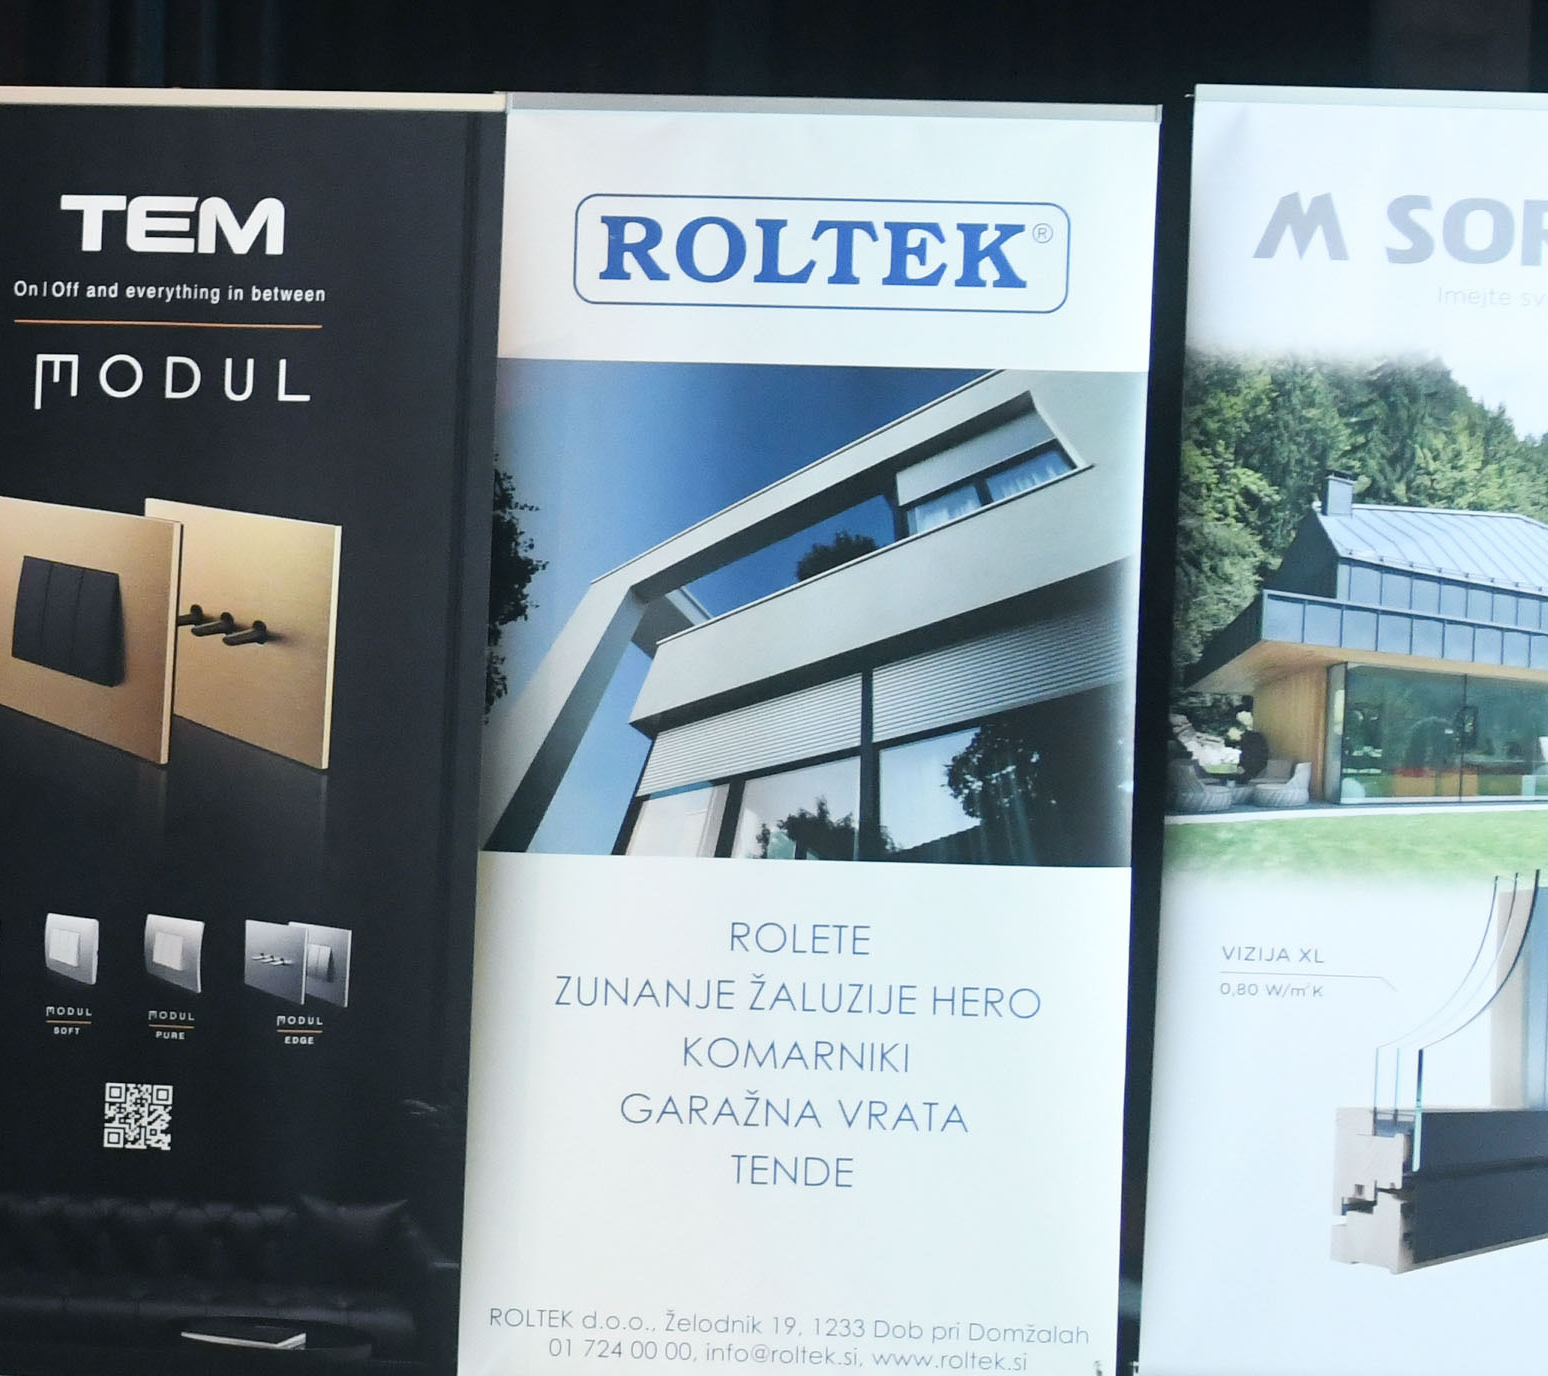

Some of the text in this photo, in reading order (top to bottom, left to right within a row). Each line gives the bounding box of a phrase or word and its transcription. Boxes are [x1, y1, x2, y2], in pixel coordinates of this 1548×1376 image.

[61, 195, 285, 255] TEM
[86, 282, 118, 298] and
[125, 284, 220, 304] everything
[228, 285, 243, 301] in
[251, 286, 326, 302] between
[34, 354, 310, 409] MODUL
[730, 922, 871, 955] ROLETE
[1221, 946, 1325, 963] VIZIJA XL
[555, 974, 1041, 1019] ZUNANJE ŽALUZIJE HERO
[1219, 982, 1259, 997] 0,80
[54, 1026, 80, 1035] SOFT
[156, 1031, 185, 1040] PURE
[284, 1036, 314, 1044] EDGE
[683, 1037, 910, 1073] KOMARNIKI
[620, 1090, 969, 1133] GARAŽNA VRATA
[731, 1154, 853, 1188] TENDE
[489, 1308, 573, 1328] ROLTEK
[665, 1310, 762, 1334] Želodnik
[772, 1316, 803, 1337] 19,
[814, 1317, 865, 1337] 1233
[874, 1320, 923, 1340] Dob
[932, 1322, 961, 1343] pri
[968, 1323, 1089, 1344] Domžalah
[549, 1338, 1028, 1371] 01 724 00 00, info@roltek.si, www.roltek.si
